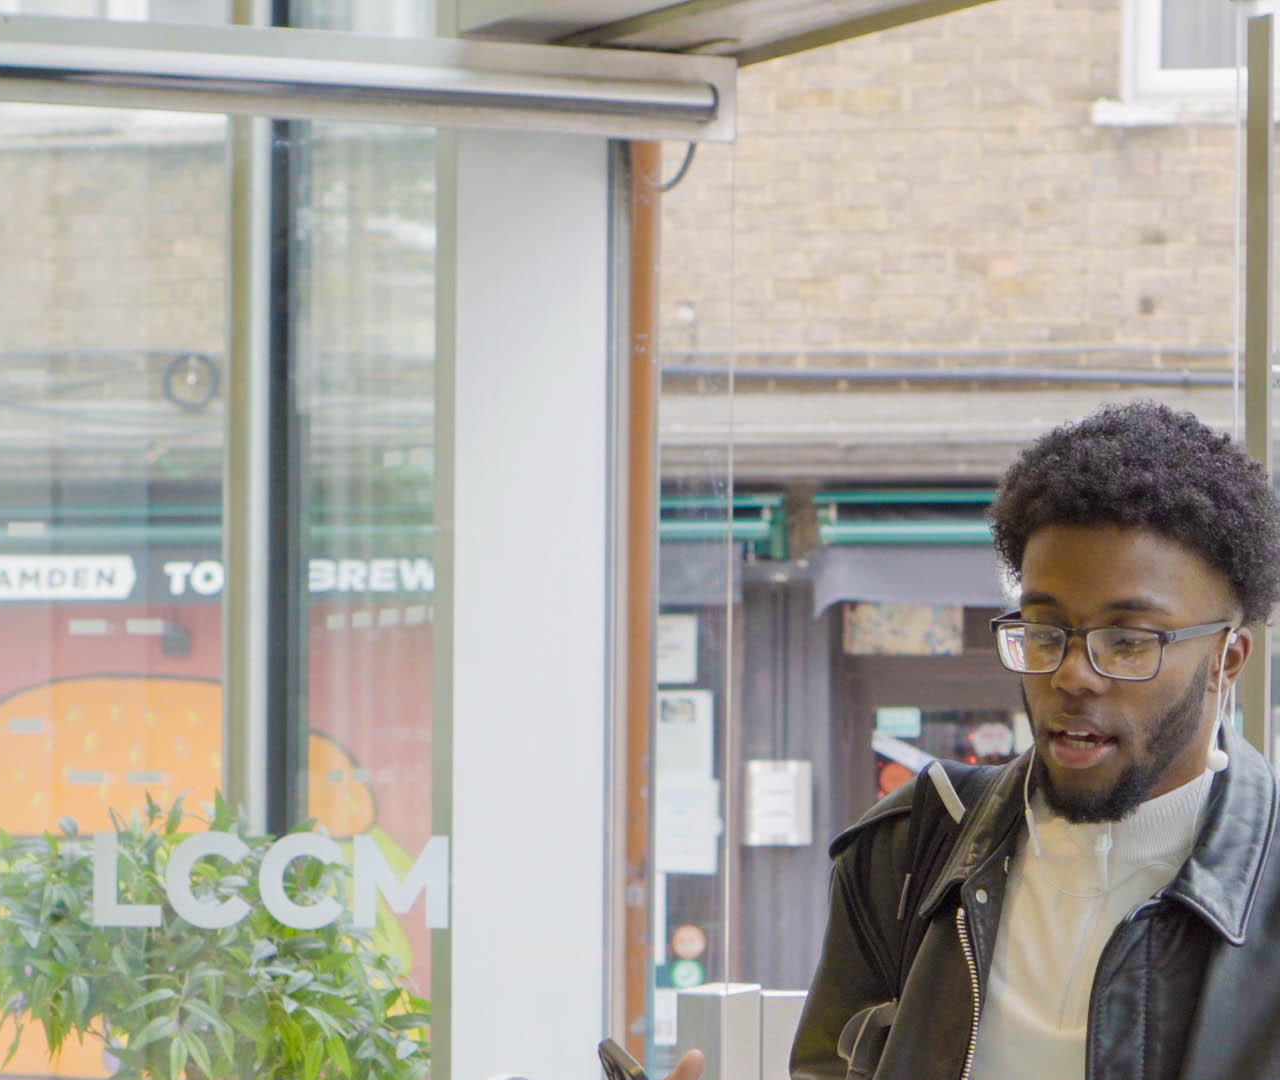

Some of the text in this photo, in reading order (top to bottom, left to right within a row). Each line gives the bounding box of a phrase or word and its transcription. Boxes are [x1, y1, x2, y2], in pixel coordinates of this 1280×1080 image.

[163, 560, 224, 595] TO
[308, 558, 435, 592] BREW
[93, 831, 449, 930] LCCM
